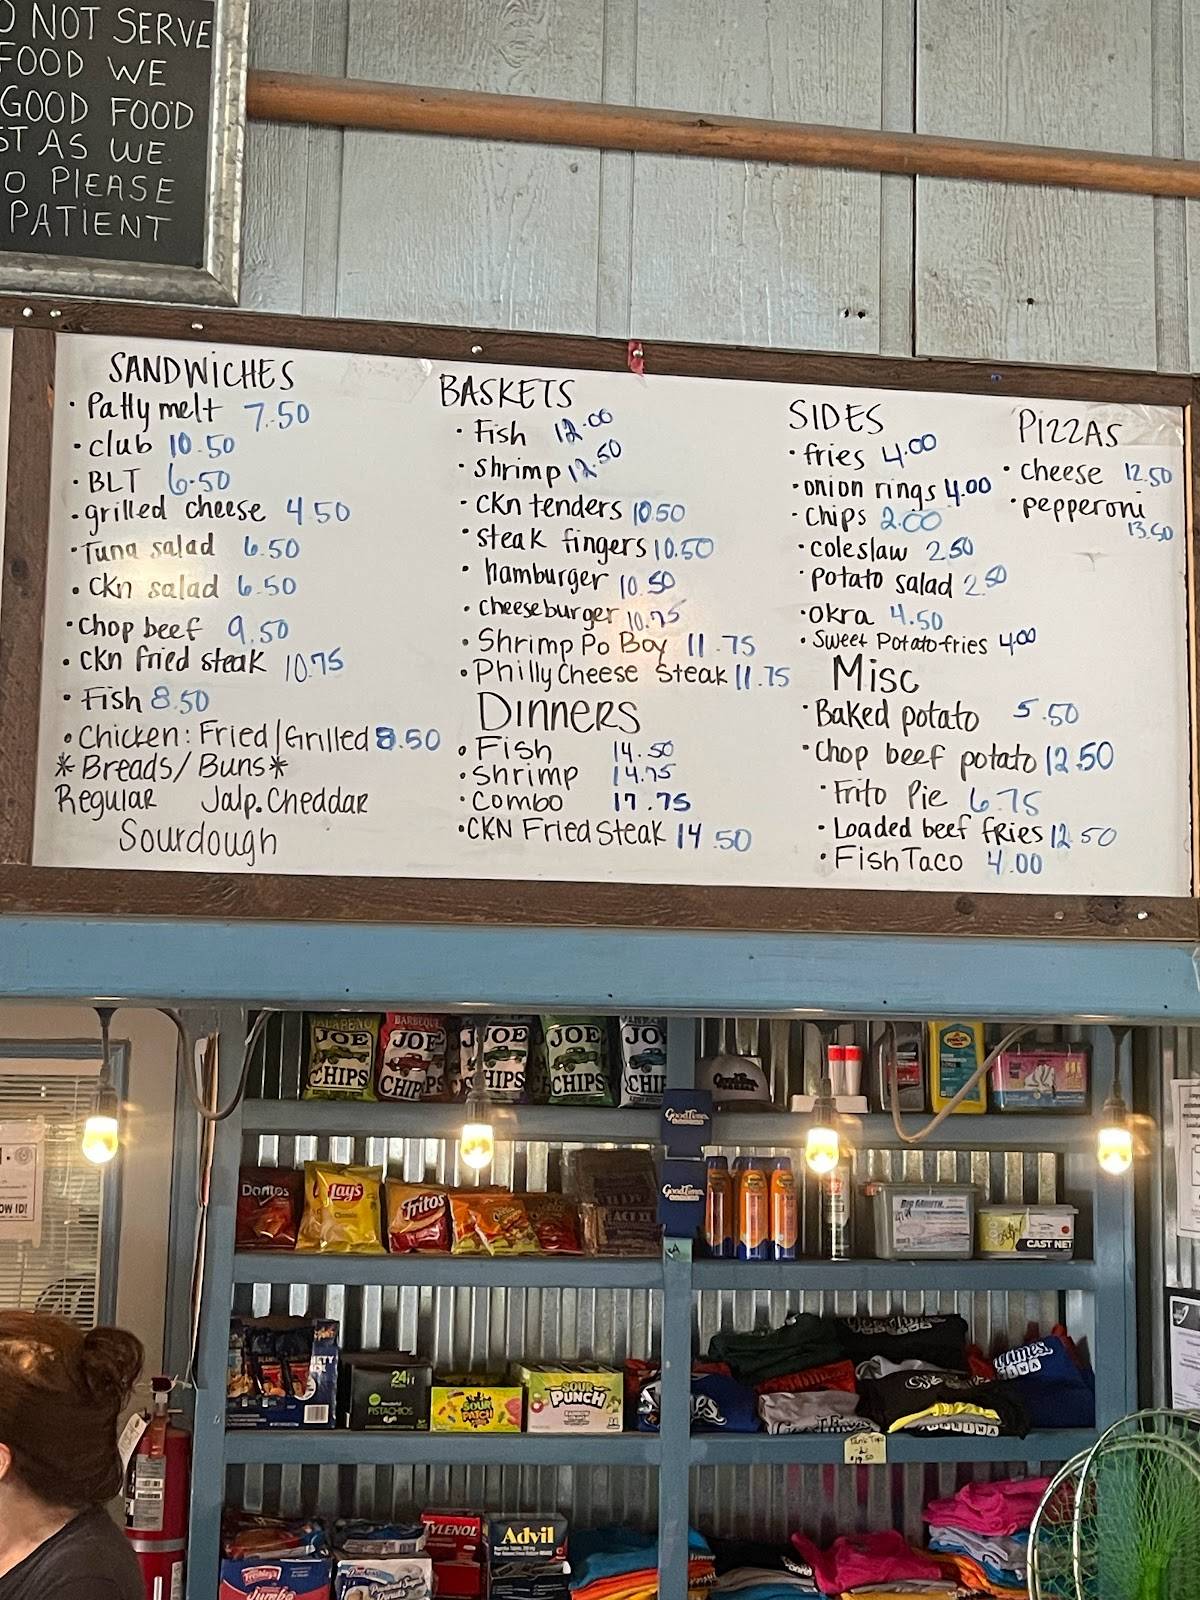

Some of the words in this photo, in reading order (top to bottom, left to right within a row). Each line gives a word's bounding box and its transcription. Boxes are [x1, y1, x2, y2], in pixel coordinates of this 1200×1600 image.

[32, 3, 101, 40] NOT
[113, 7, 213, 49] SERVE
[0, 42, 84, 78] FOOD
[107, 56, 168, 87] WE
[0, 85, 89, 124] GOOD
[110, 97, 194, 130] FOOD
[38, 129, 88, 160] AS
[110, 137, 166, 165] WE
[440, 373, 576, 409] BASKETS
[88, 392, 149, 433] Patty
[159, 393, 222, 423] melt
[244, 400, 310, 432] 7.50
[789, 399, 884, 435] SIDES
[89, 432, 152, 457] club
[168, 432, 235, 458] 10.50
[474, 419, 527, 446] Fish
[804, 442, 866, 471] fries
[882, 433, 938, 469] 4.00
[89, 467, 140, 493] BLT
[168, 463, 231, 495] 6.50
[1021, 458, 1104, 486] cheese
[1124, 462, 1173, 488] 12.50
[804, 475, 864, 500] onion
[875, 478, 936, 512] rings
[944, 476, 992, 507] 4.00
[1022, 490, 1146, 523] pepperoni
[85, 495, 167, 536] grilled
[186, 495, 266, 522] cheese
[529, 492, 623, 521] tenders
[633, 500, 686, 526] 10.50
[880, 507, 942, 533] 2.00
[80, 539, 138, 565] Tuna
[151, 532, 216, 559] salad
[244, 536, 300, 559] 6.50
[562, 527, 647, 565] fingers
[655, 537, 714, 561] 10.50
[810, 536, 908, 563] coleslaw
[148, 574, 219, 599] salad
[238, 575, 297, 597] 6.50
[485, 557, 610, 594] hamburger
[620, 570, 676, 599] 10.50
[896, 573, 953, 599] salad
[627, 598, 687, 632] 10.75
[890, 603, 944, 631] 4.50
[145, 616, 203, 641] beef
[227, 615, 289, 645] 9.50
[812, 629, 869, 650] Sweet
[999, 627, 1037, 656] 4.00
[478, 627, 573, 662] Shrimp
[582, 634, 610, 656] Po
[620, 630, 668, 666] Boy
[687, 633, 756, 658] 11.75
[136, 645, 189, 672] fried
[201, 647, 267, 674] steak
[285, 647, 344, 682] 10.75
[735, 664, 791, 690] 11.75
[832, 653, 920, 694] Misc
[81, 685, 142, 713] Fish
[150, 686, 209, 714] 8.50
[815, 698, 889, 729] Baked
[901, 700, 980, 736] potato
[376, 727, 441, 751] 8.50
[476, 735, 552, 764] Fish
[613, 740, 675, 763] 14.50
[613, 763, 677, 786] 14.75
[886, 743, 945, 766] beef
[961, 743, 1038, 782] potato
[472, 791, 563, 813] Combo
[614, 792, 691, 812] 17.75
[834, 779, 887, 808] Frito
[908, 779, 948, 810] Pie
[969, 787, 1042, 817] 6.75
[467, 817, 512, 841] CKN
[522, 817, 591, 844] Fried
[834, 816, 911, 840] Loaded
[922, 814, 972, 840] beef
[119, 818, 277, 866] Sourdough
[835, 845, 899, 872] Fish
[902, 847, 963, 872] Taco
[987, 850, 1043, 875] 4.00
[316, 1030, 369, 1046] JOE
[551, 1026, 602, 1047] JOE
[625, 1027, 667, 1045] JO
[309, 1066, 369, 1087] CHIPS
[484, 1070, 526, 1088] HIPS
[551, 1072, 606, 1095] CHIPS
[242, 1184, 289, 1199] Doritos
[402, 1194, 445, 1221] Fritos
[1027, 1240, 1052, 1249] CAST
[1054, 1240, 1073, 1249] NET
[550, 1391, 606, 1408] PUNCH
[562, 1382, 594, 1392] SOUR
[462, 1410, 493, 1421] PATCH
[463, 1401, 491, 1411] SOUR
[423, 1521, 478, 1537] TYLENOL
[501, 1526, 555, 1545] Advil
